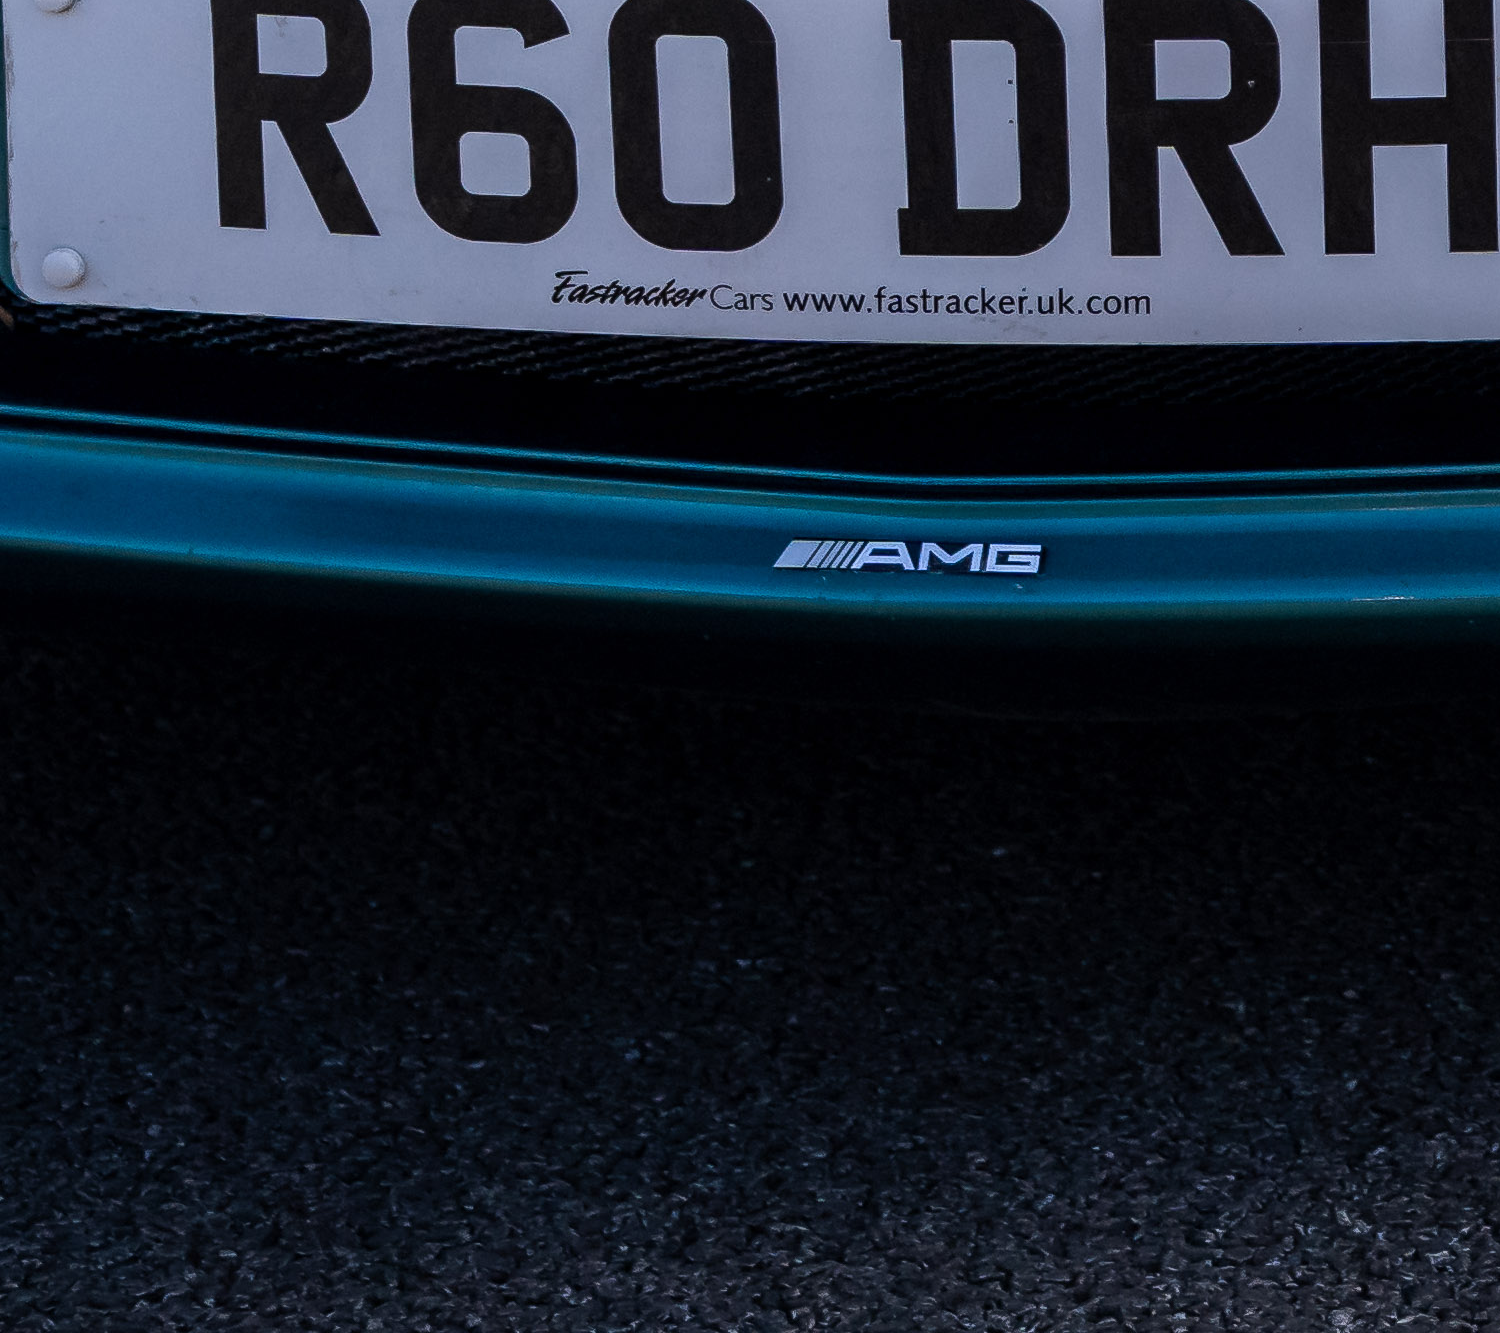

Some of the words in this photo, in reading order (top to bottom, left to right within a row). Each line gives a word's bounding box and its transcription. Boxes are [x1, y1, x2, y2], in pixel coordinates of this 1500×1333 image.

[551, 270, 708, 308] Fastracker
[709, 284, 774, 311] Cars
[782, 285, 1151, 315] www.fastracker.uk.com
[850, 540, 1042, 574] AMG
